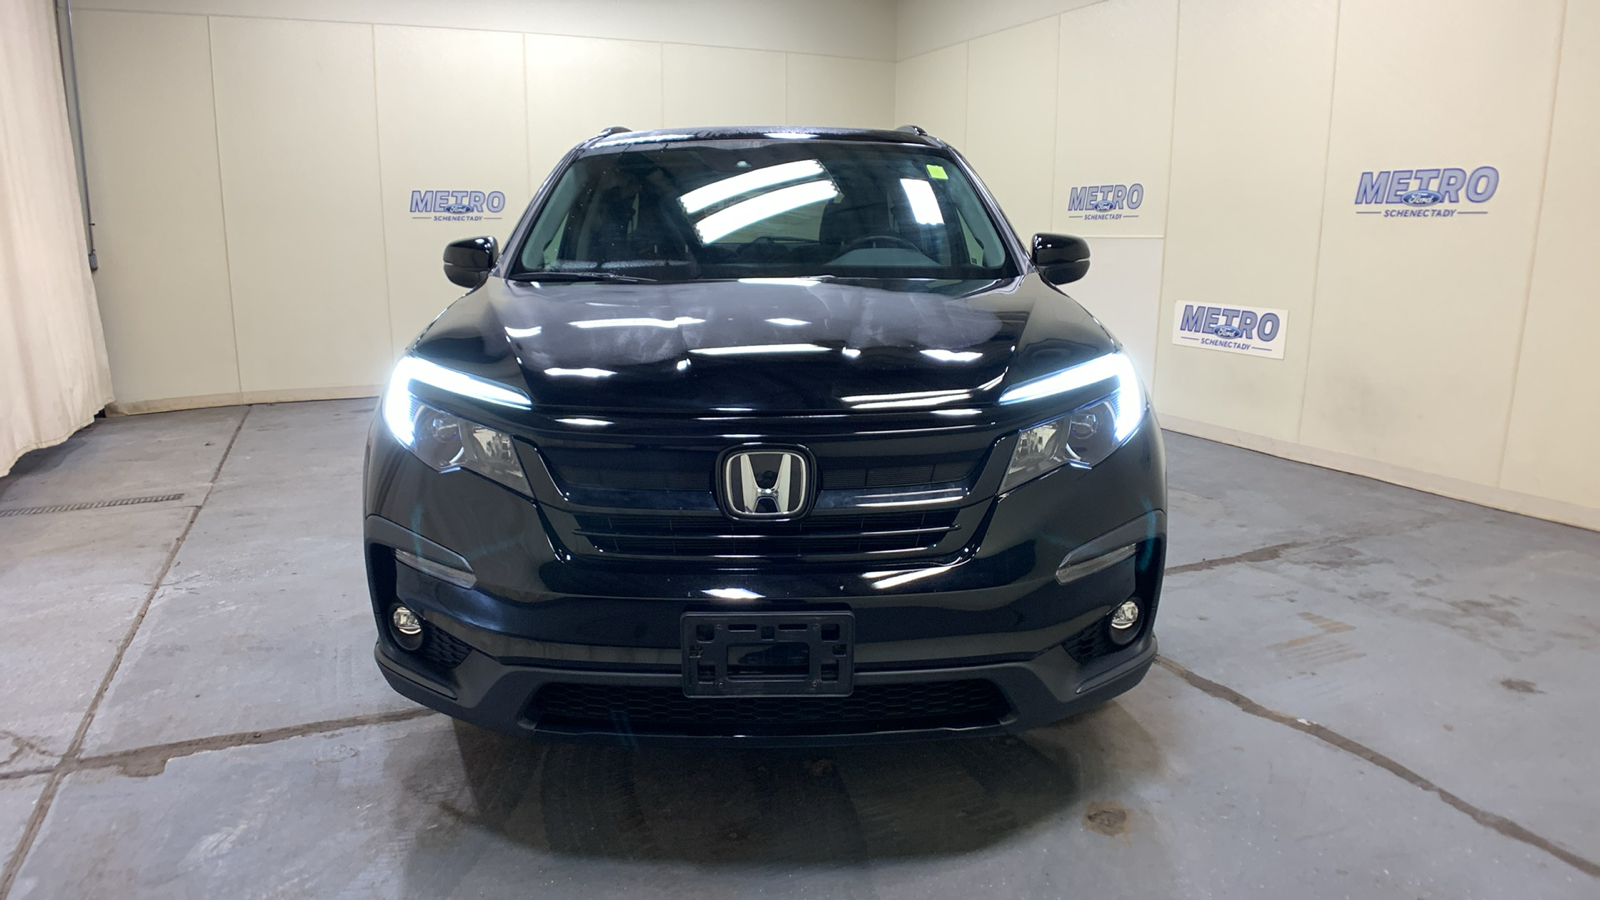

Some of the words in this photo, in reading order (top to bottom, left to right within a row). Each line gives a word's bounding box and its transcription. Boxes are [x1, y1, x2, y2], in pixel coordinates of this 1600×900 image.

[1354, 166, 1499, 204] METRO
[410, 190, 505, 213] METRO
[1068, 183, 1144, 211] METRO
[1408, 192, 1435, 204] Ford
[1383, 209, 1457, 217] SCHENECTADY
[1180, 304, 1280, 342] METRO
[1201, 337, 1251, 350] SCHENECTADY
